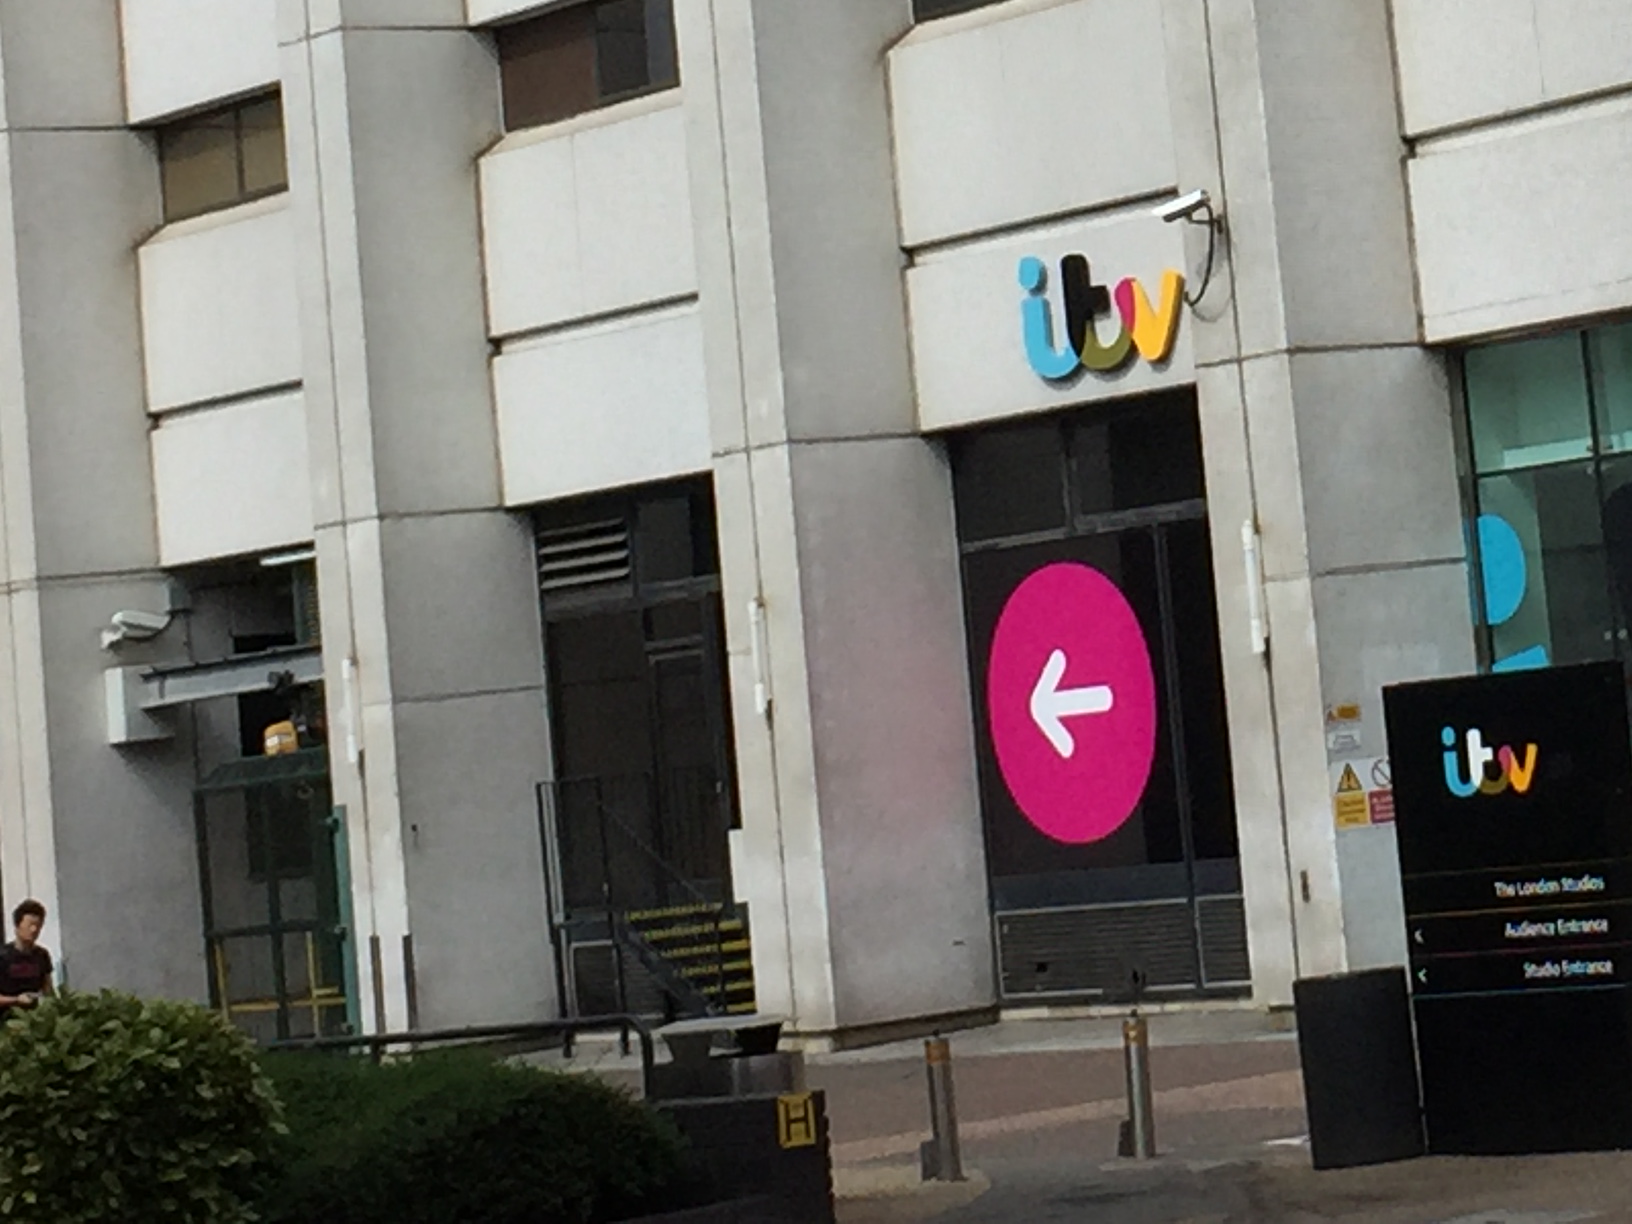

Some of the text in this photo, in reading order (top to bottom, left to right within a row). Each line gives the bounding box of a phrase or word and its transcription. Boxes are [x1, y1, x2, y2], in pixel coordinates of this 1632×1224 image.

[1017, 253, 1186, 384] itv
[1441, 726, 1538, 797] itv
[1494, 874, 1605, 897] The London Studios
[1504, 918, 1608, 938] Audience Entrance
[1523, 959, 1614, 978] Studio Entrance
